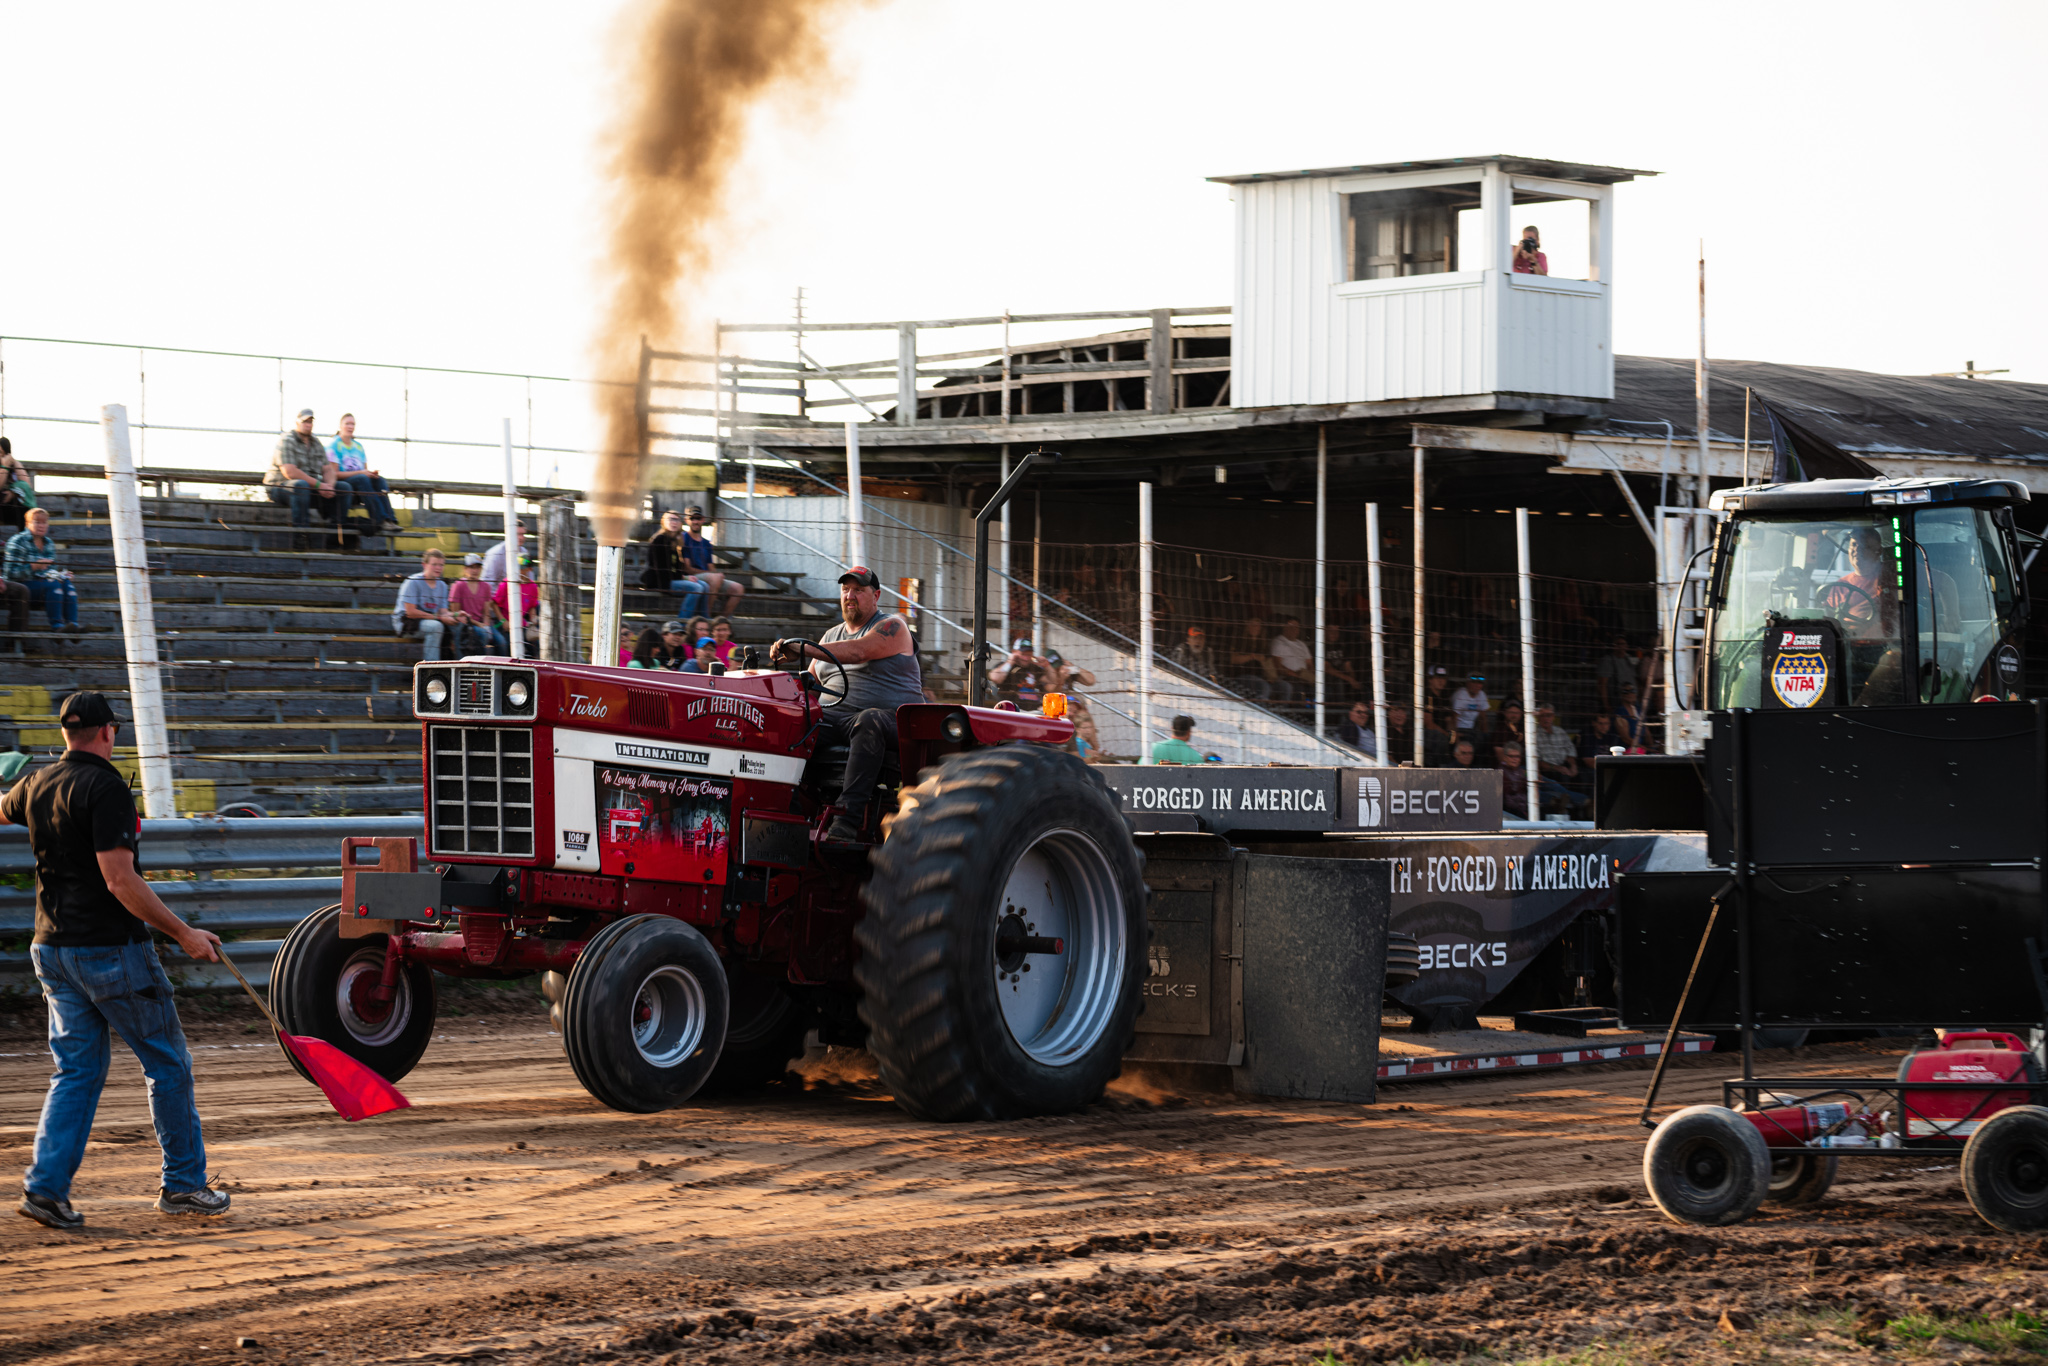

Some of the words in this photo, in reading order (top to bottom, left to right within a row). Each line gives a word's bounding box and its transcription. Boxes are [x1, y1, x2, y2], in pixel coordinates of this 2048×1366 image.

[1784, 676, 1815, 692] NTPA
[570, 694, 608, 718] Turbo
[687, 697, 708, 722] V.V.
[710, 696, 765, 734] HERITAGE
[617, 744, 708, 764] INTERNATIONAL
[601, 769, 613, 785] In
[613, 771, 637, 791] Loving
[637, 773, 668, 794] Memory
[668, 778, 677, 795] of
[676, 778, 700, 798] Jerry
[699, 780, 730, 801] Eisenga
[1132, 787, 1204, 810] FORGED
[1212, 788, 1233, 810] IN
[1240, 788, 1327, 812] AMERICA
[1390, 790, 1480, 814] BECK'S
[568, 832, 585, 843] 1066
[1386, 857, 1413, 894] TH
[1427, 855, 1498, 893] FORGED
[1504, 855, 1525, 891] IN
[1530, 853, 1610, 891] AMERICA
[1418, 942, 1507, 970] BECK'S
[1143, 982, 1198, 998] ECK'S
